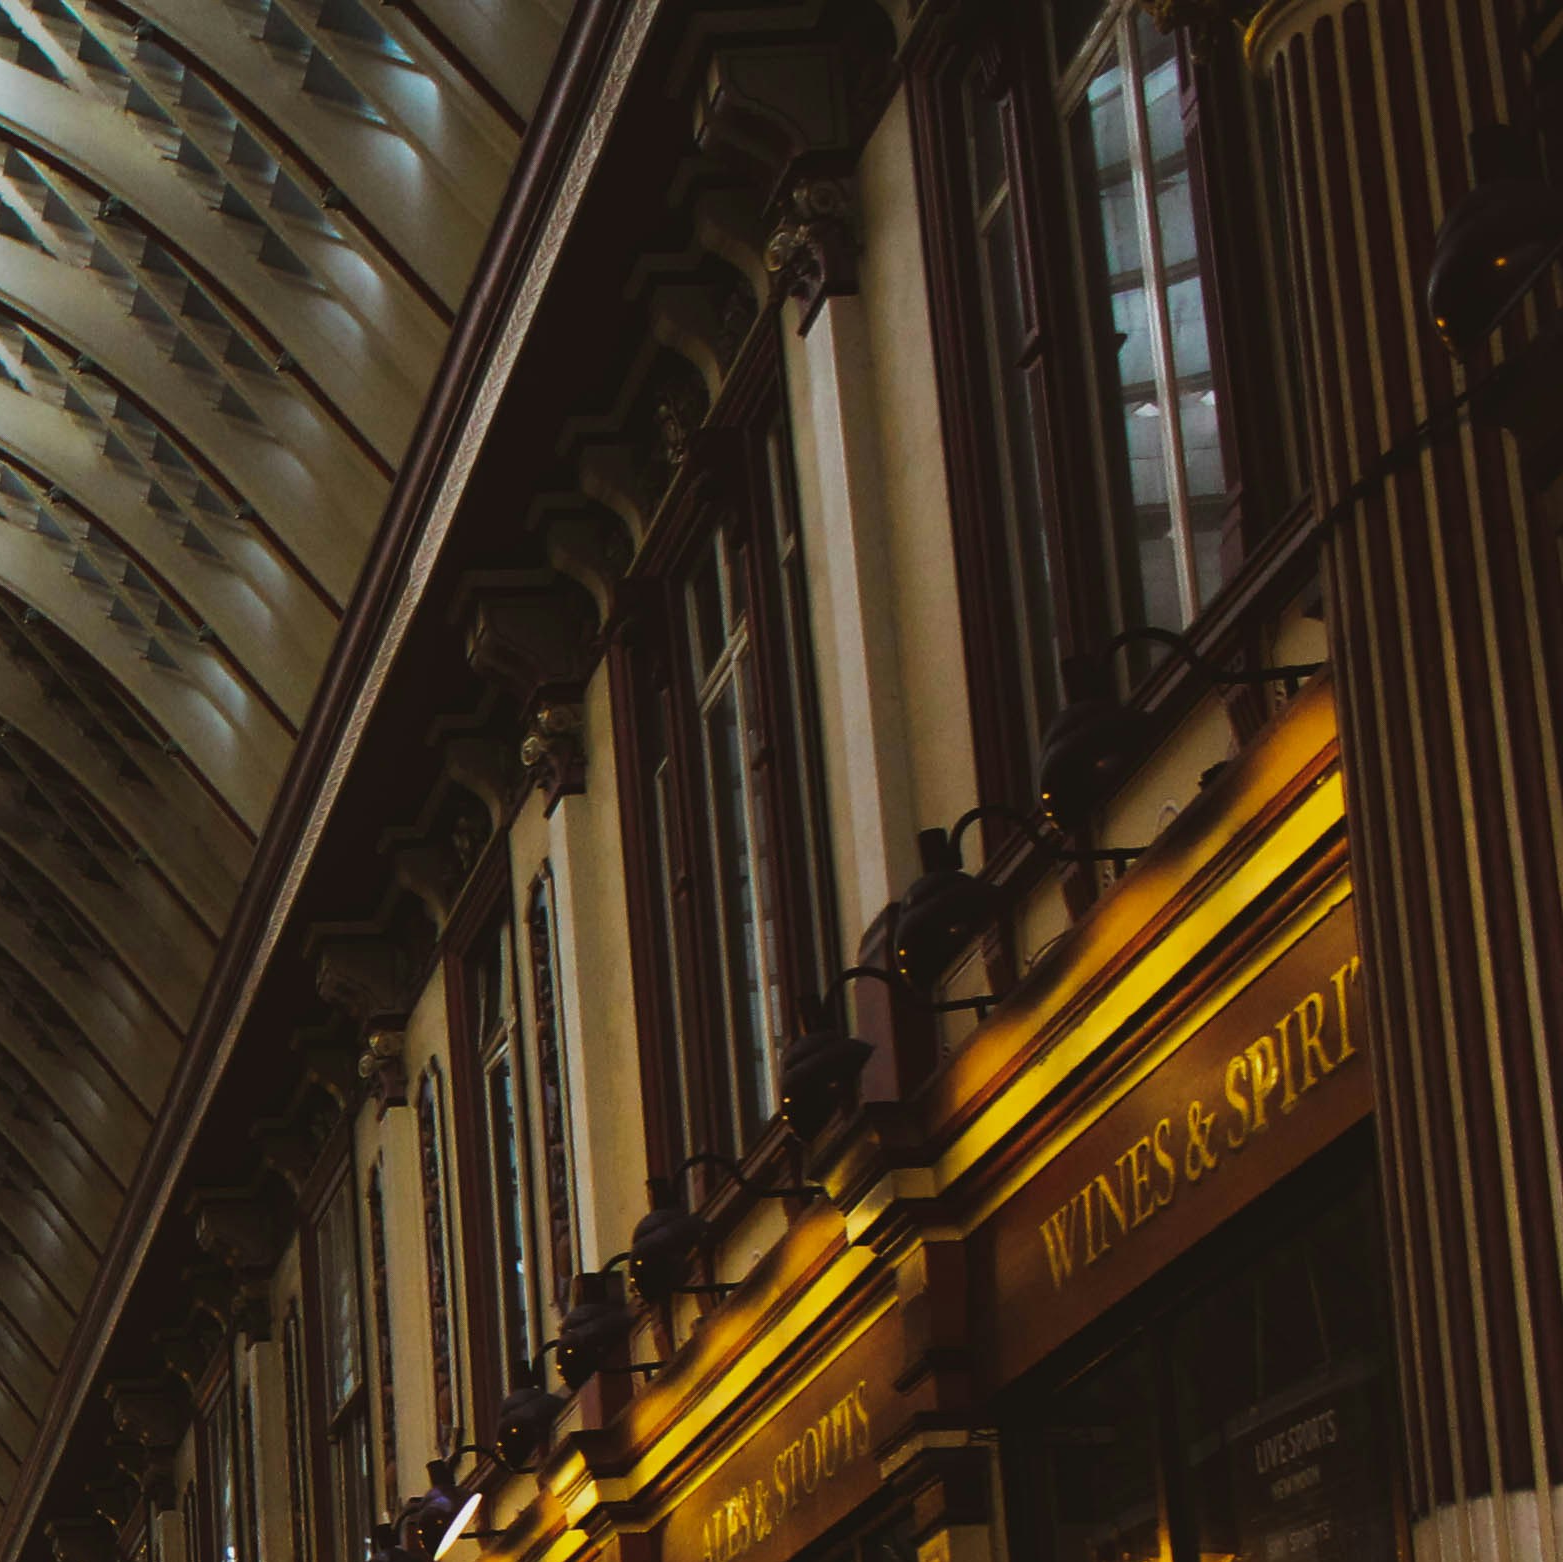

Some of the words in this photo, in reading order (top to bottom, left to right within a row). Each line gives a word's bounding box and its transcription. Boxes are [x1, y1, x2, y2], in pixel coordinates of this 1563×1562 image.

[1038, 1118, 1176, 1288] WINES
[1184, 1100, 1217, 1181] &
[1224, 955, 1362, 1149] SPIRI
[754, 1480, 773, 1542] &
[774, 1380, 870, 1525] STOUTS
[1253, 1431, 1289, 1476] LIVE
[1285, 1408, 1338, 1459] SPORTS
